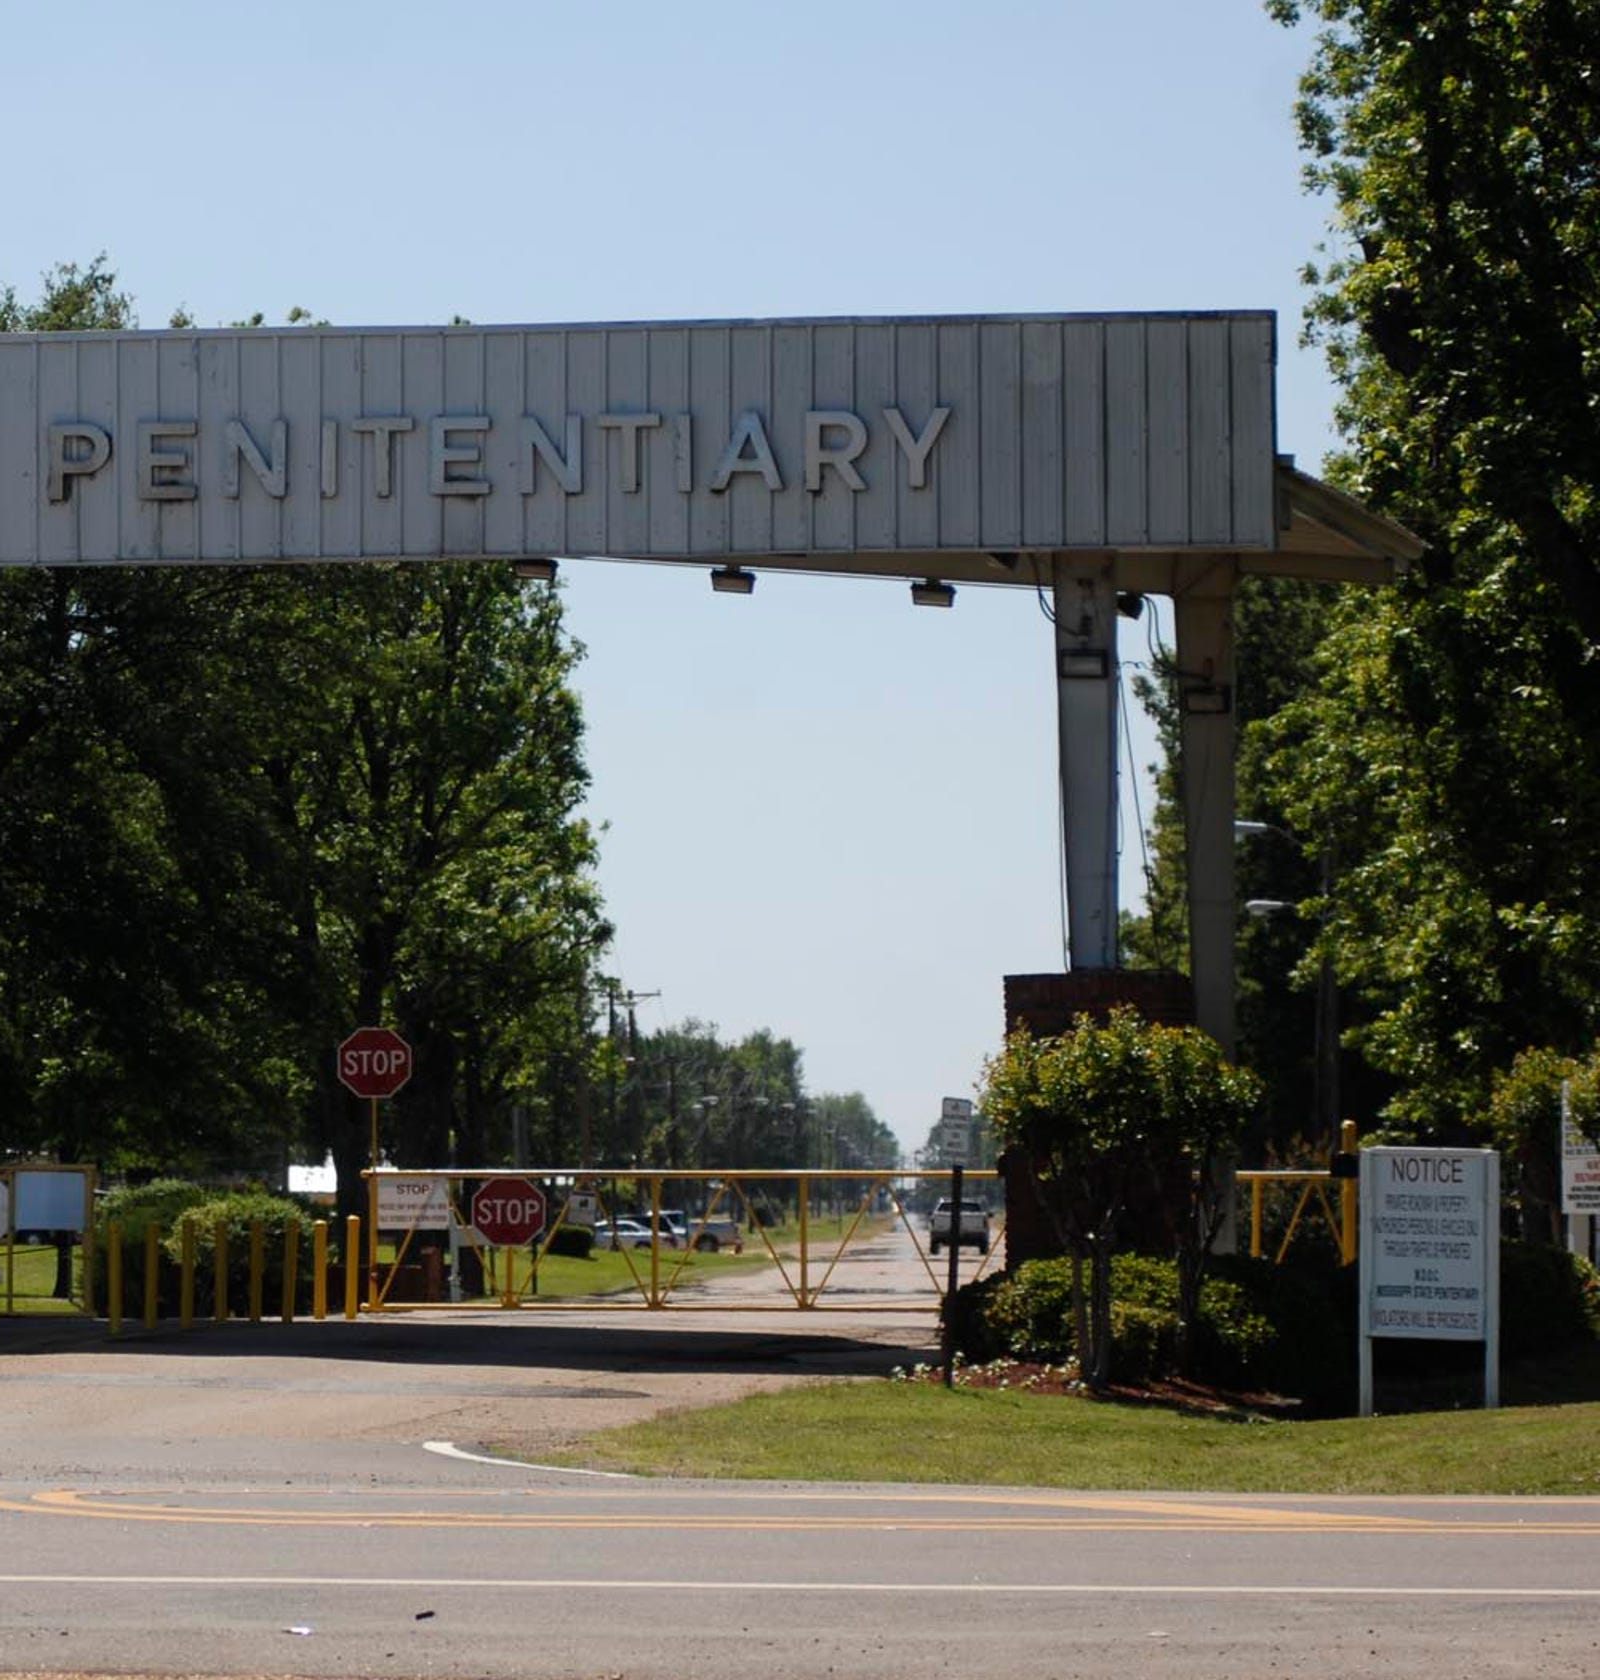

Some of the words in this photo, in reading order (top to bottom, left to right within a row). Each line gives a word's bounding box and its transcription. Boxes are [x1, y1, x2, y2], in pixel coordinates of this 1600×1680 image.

[46, 405, 952, 504] PENITENTIARY
[343, 1049, 406, 1077] STOP
[1391, 1157, 1464, 1183] NOTICE
[395, 1183, 430, 1195] STOP
[477, 1197, 540, 1226] STOP
